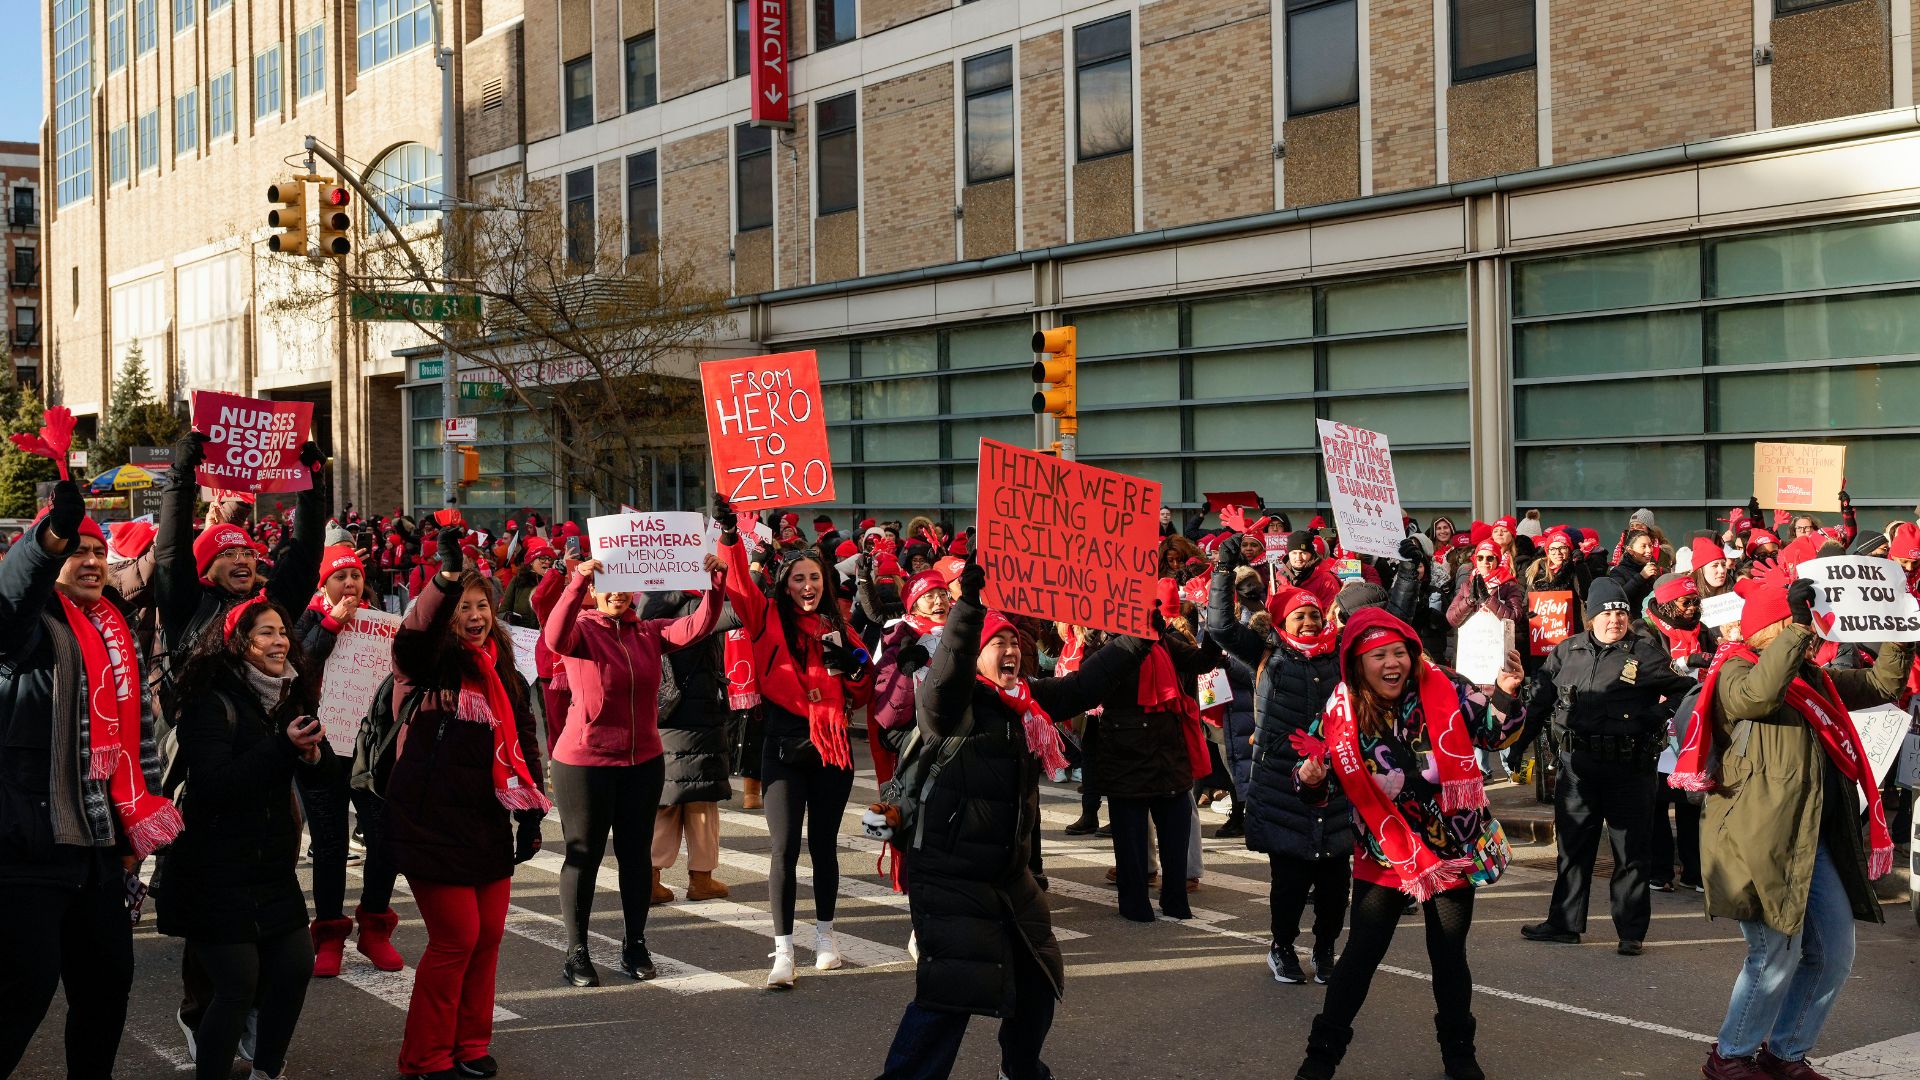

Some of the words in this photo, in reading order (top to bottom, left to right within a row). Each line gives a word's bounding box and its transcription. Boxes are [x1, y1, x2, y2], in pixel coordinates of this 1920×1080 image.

[442, 298, 460, 317] St
[462, 386, 469, 397] W
[492, 385, 500, 393] St
[730, 368, 792, 393] FROM
[220, 406, 296, 430] NURSES
[716, 388, 812, 436] HERO
[210, 424, 298, 450] DESERVE
[746, 432, 786, 459] TO
[1334, 422, 1376, 447] STOP
[149, 448, 170, 456] 3959
[226, 447, 281, 468] GOOD
[1322, 436, 1390, 470] PROFITING
[200, 462, 252, 480] HEALTH
[256, 468, 302, 480] BENEFITS
[728, 458, 828, 503] ZERO
[984, 442, 1071, 498] THINK
[1079, 470, 1154, 516] WE'RE
[1326, 454, 1351, 478] OFF
[1354, 462, 1392, 487] NURSE
[1336, 476, 1395, 505] BURNOUT
[630, 516, 666, 532] MÁS
[994, 486, 1086, 530] GIVING
[1103, 508, 1134, 538] UP
[599, 533, 702, 548] ENFERMERAS
[628, 549, 675, 560] MENOS
[1133, 546, 1159, 577] US
[608, 561, 700, 575] MILLONARIO$
[984, 551, 1034, 584] HOW
[1042, 561, 1097, 594] LONG
[1106, 573, 1142, 604] WE
[1826, 564, 1886, 581] HONK
[1824, 586, 1845, 602] IF
[1858, 586, 1896, 602] YOU
[996, 582, 1060, 618] WAIT
[1064, 592, 1092, 622] TO
[1103, 598, 1151, 637] PEE!
[1532, 620, 1570, 642] Nurses!
[1838, 615, 1920, 632] NURSES
[326, 732, 356, 744] ontrac
[1868, 708, 1900, 764] BONUSES
